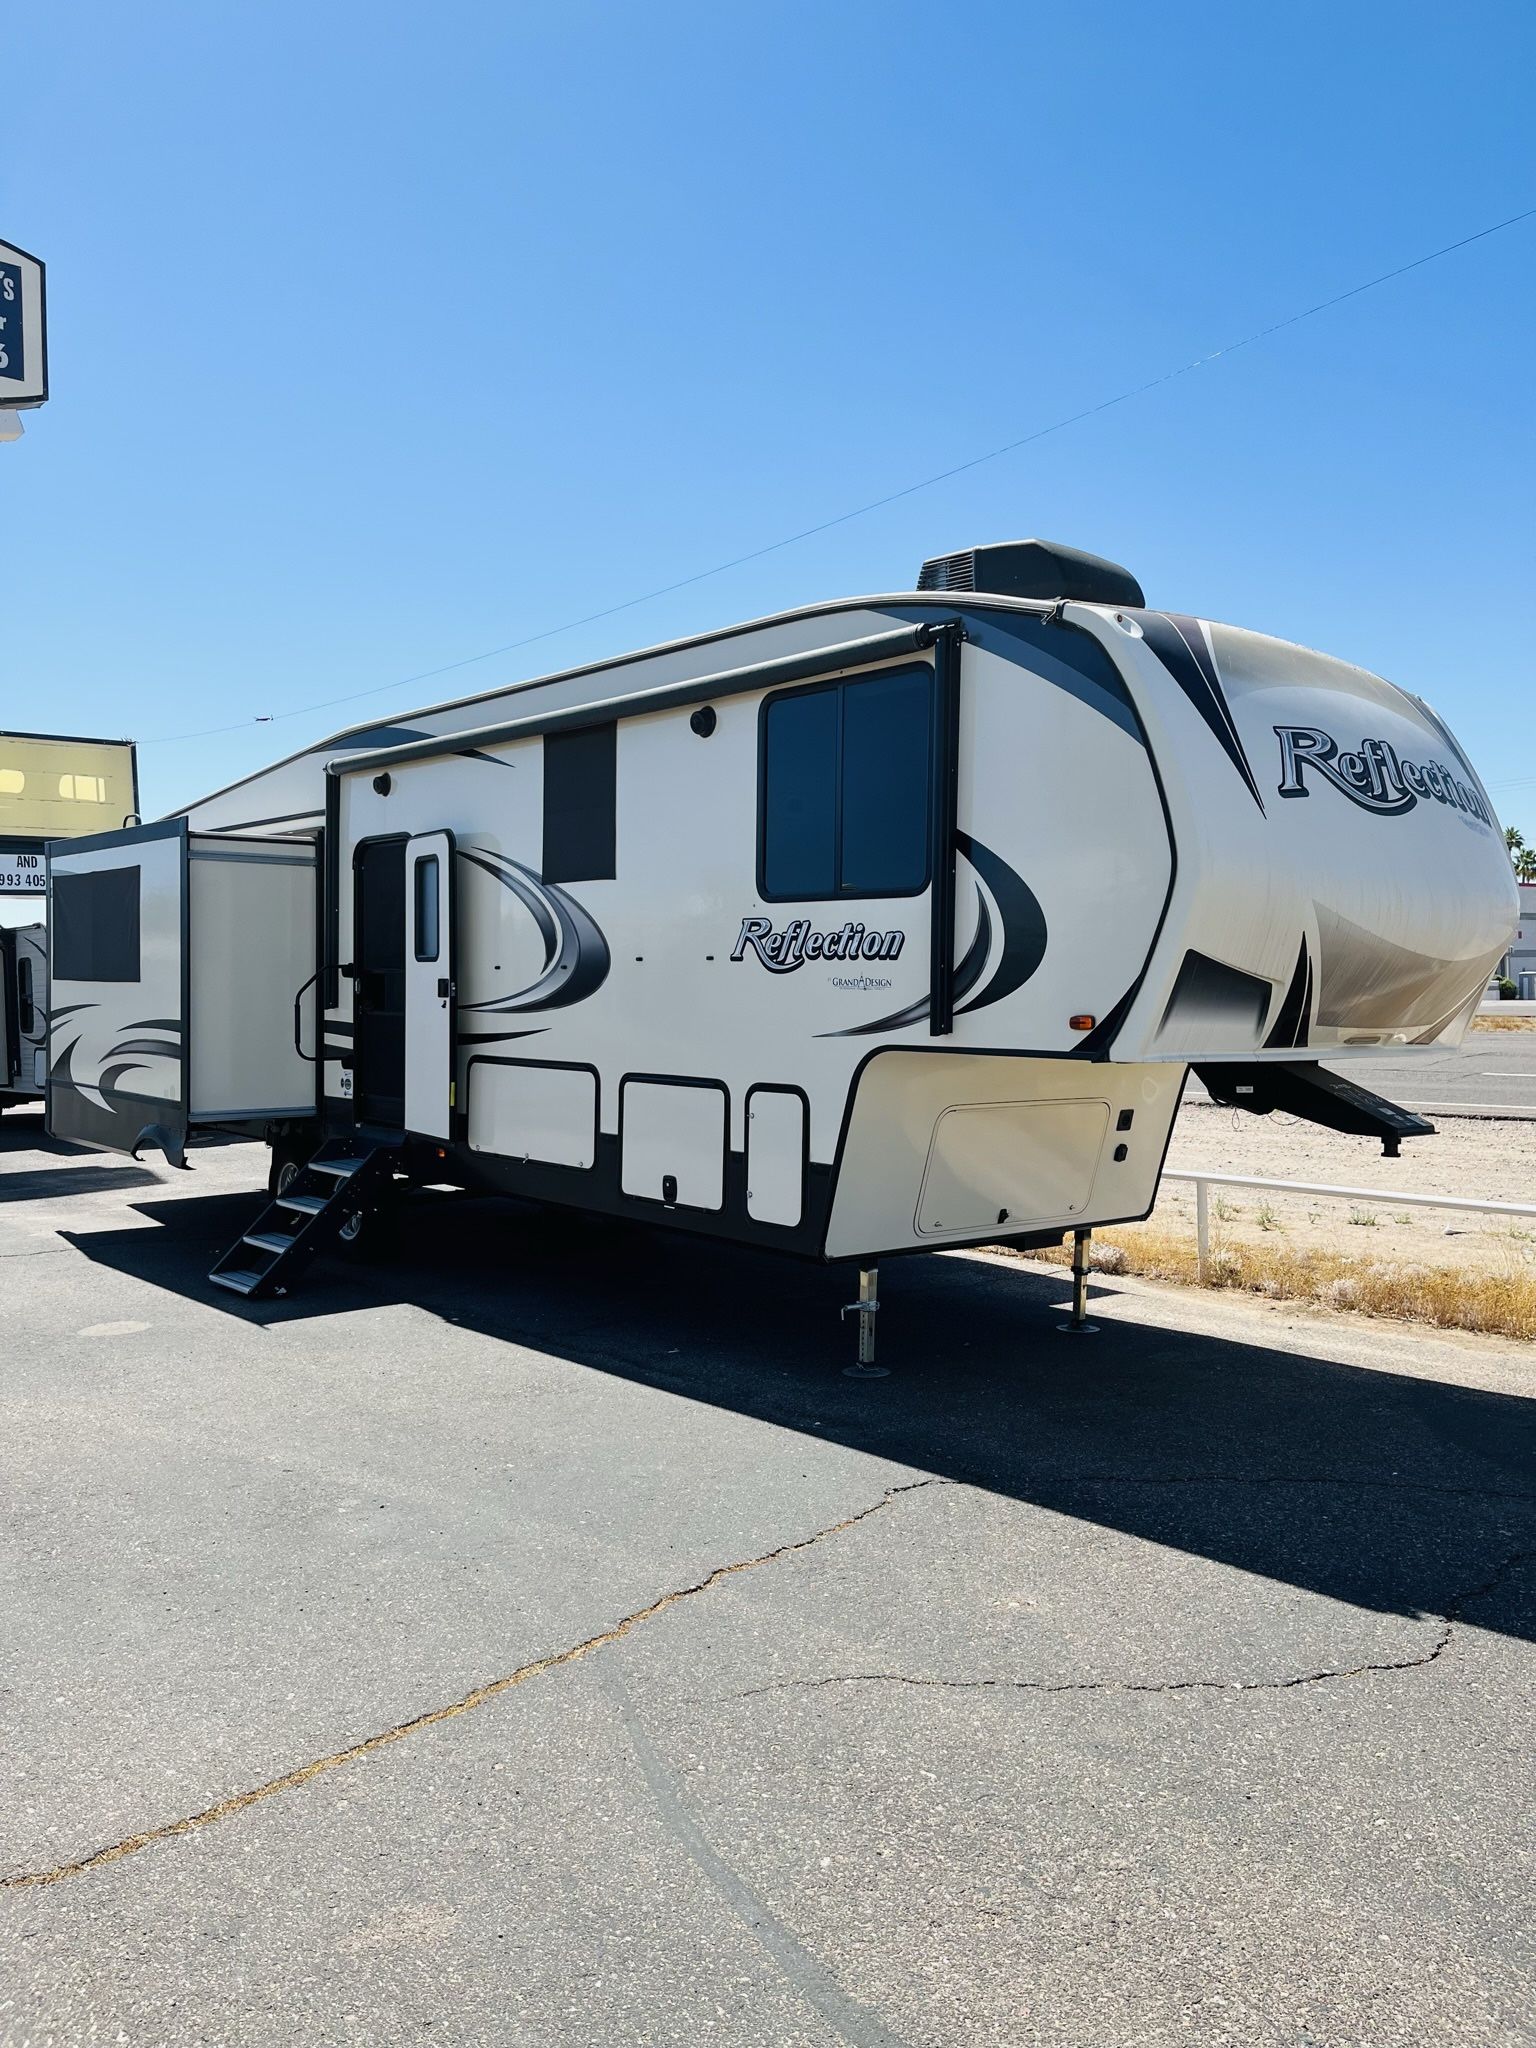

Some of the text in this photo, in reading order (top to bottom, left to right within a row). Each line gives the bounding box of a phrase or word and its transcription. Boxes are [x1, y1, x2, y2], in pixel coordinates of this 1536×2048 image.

[1273, 725, 1492, 829] Reflection
[16, 855, 38, 868] AND
[730, 917, 905, 974] Reflection
